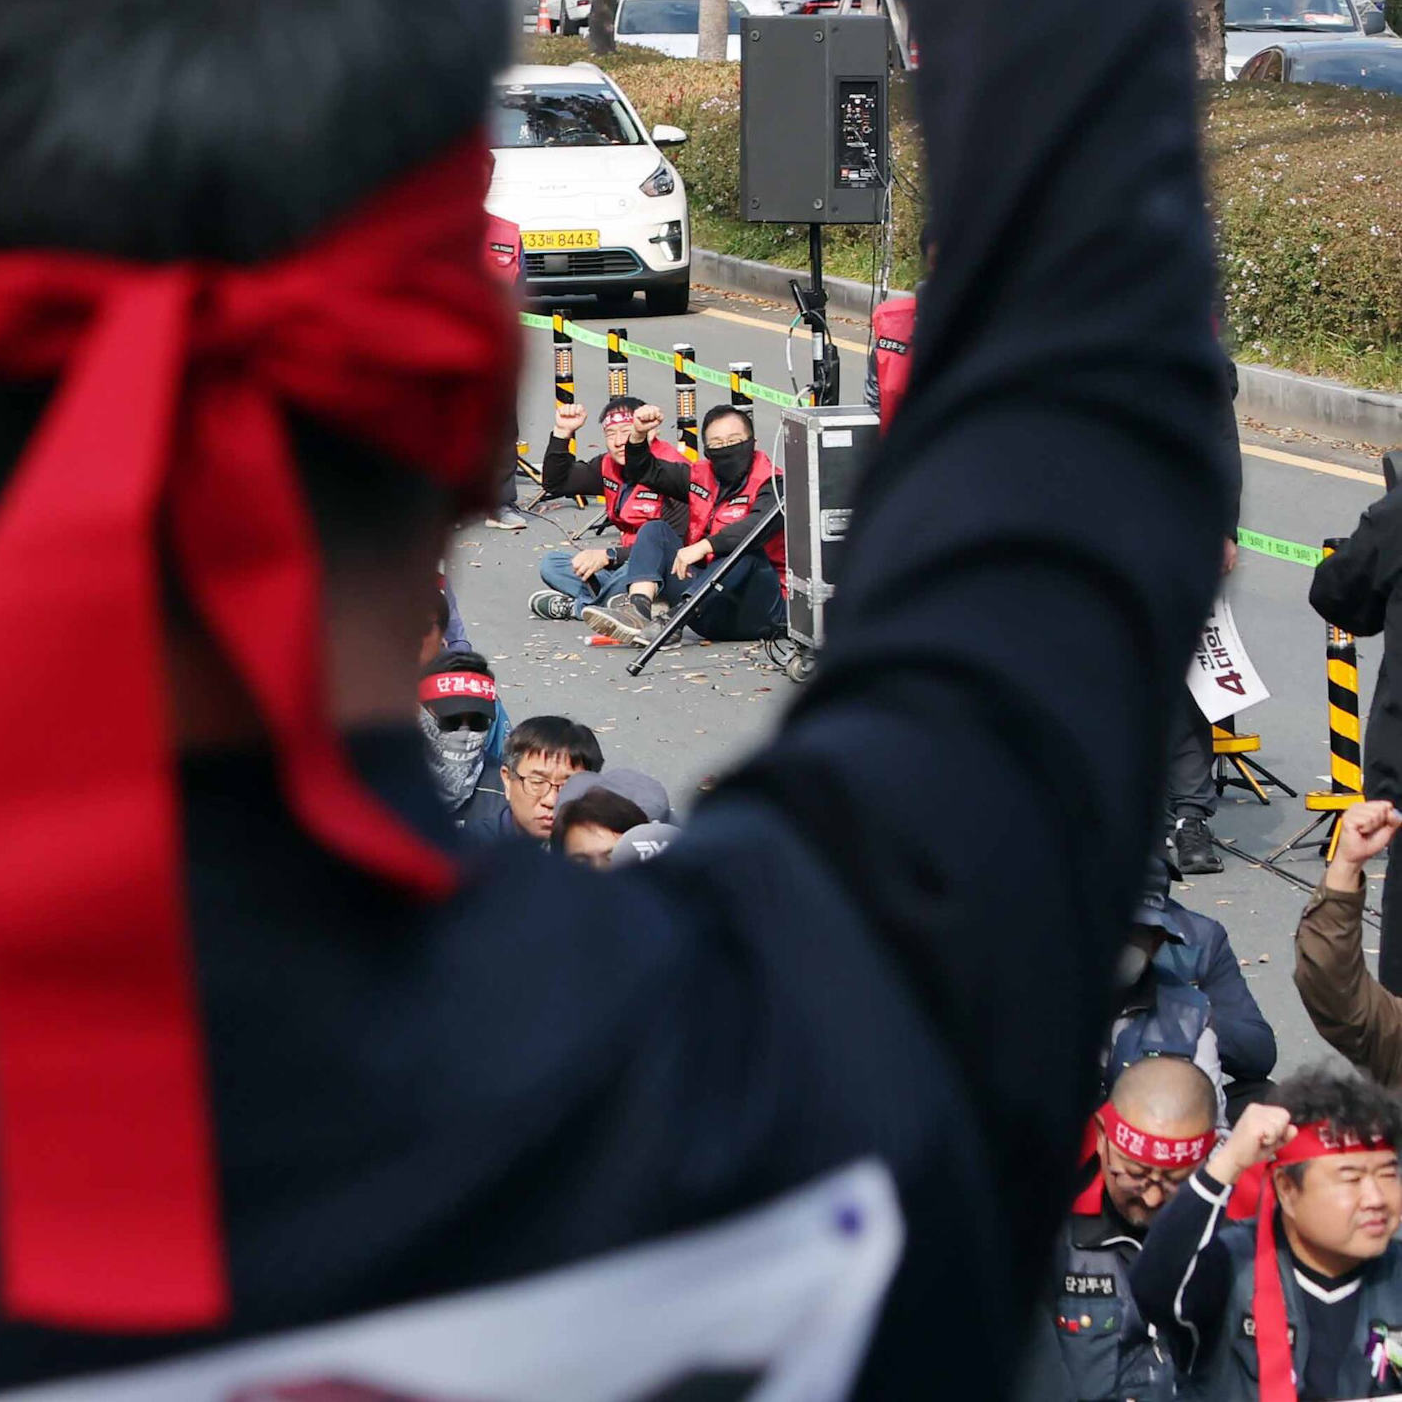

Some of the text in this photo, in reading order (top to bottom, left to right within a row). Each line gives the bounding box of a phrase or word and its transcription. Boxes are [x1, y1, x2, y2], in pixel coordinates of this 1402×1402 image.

[556, 232, 593, 247] 8443
[437, 678, 465, 693] 단결
[1116, 1122, 1204, 1162] 단결 투쟁
